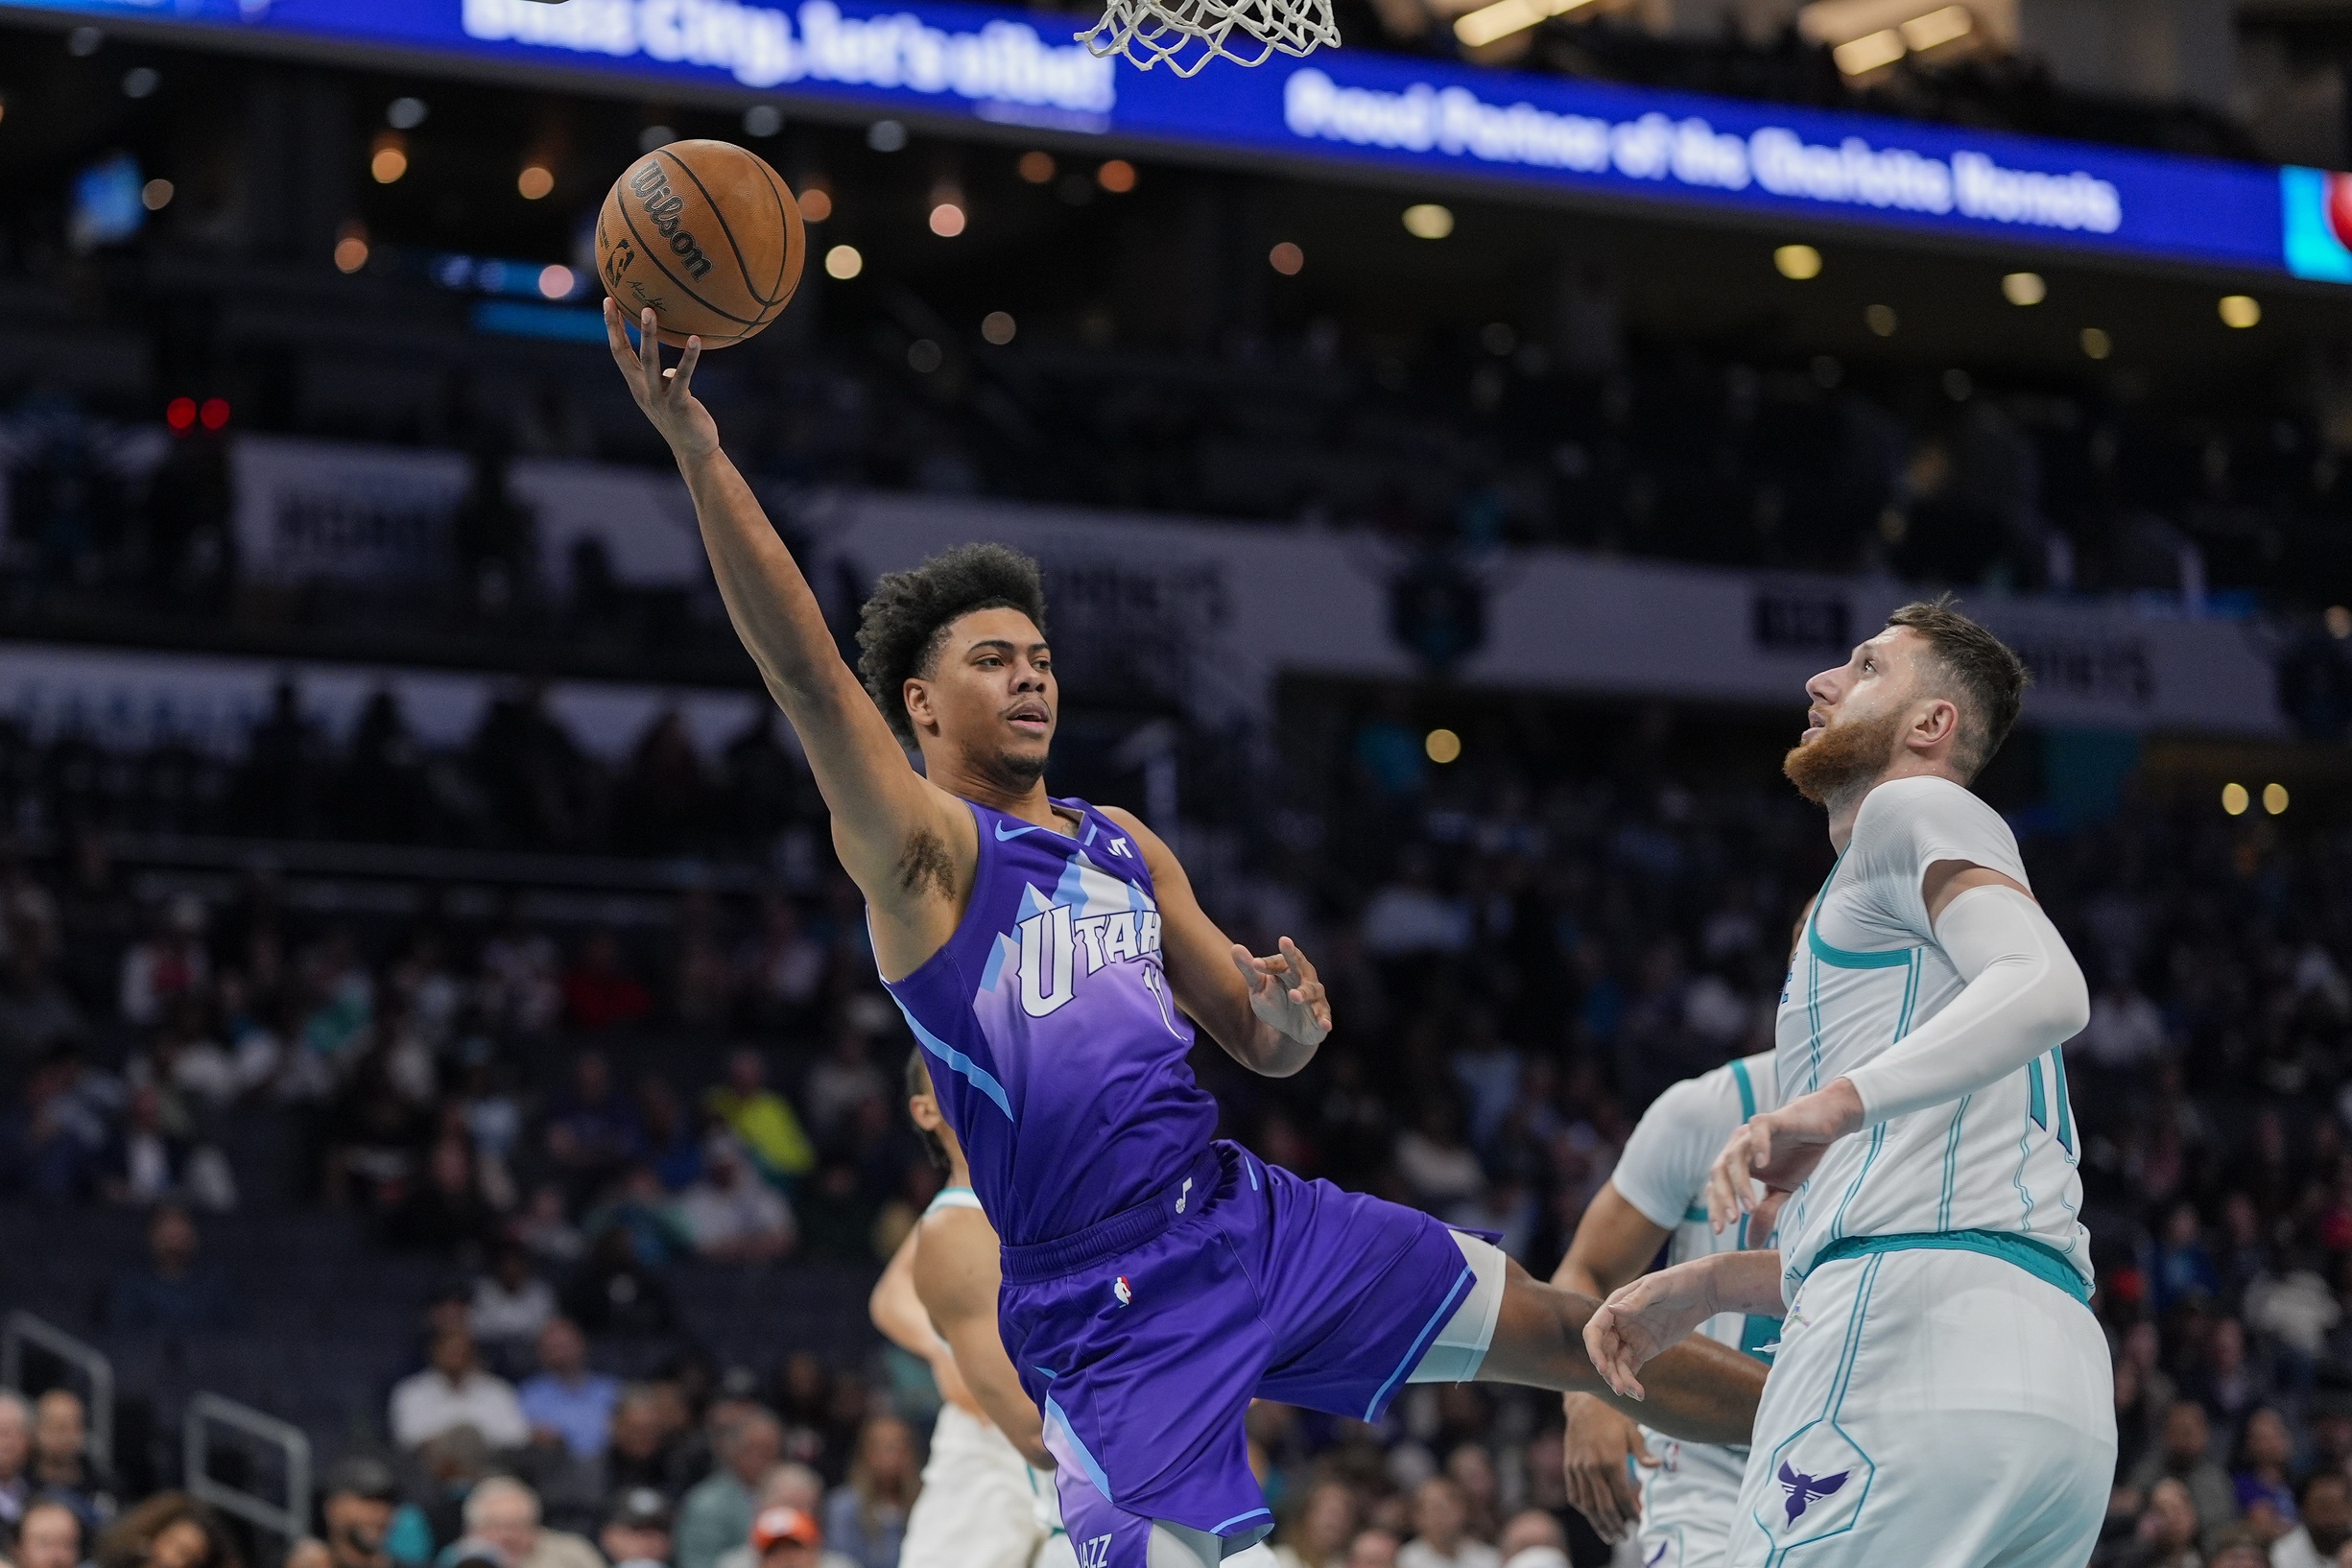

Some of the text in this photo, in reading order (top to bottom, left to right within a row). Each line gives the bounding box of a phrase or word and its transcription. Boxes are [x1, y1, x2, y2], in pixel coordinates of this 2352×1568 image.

[1284, 67, 1436, 153] Proud
[1438, 85, 1610, 174] Partner
[1610, 111, 1672, 179] of
[1670, 116, 1752, 191] the
[630, 158, 714, 284] Wilson
[1015, 903, 1163, 1018] UTAH
